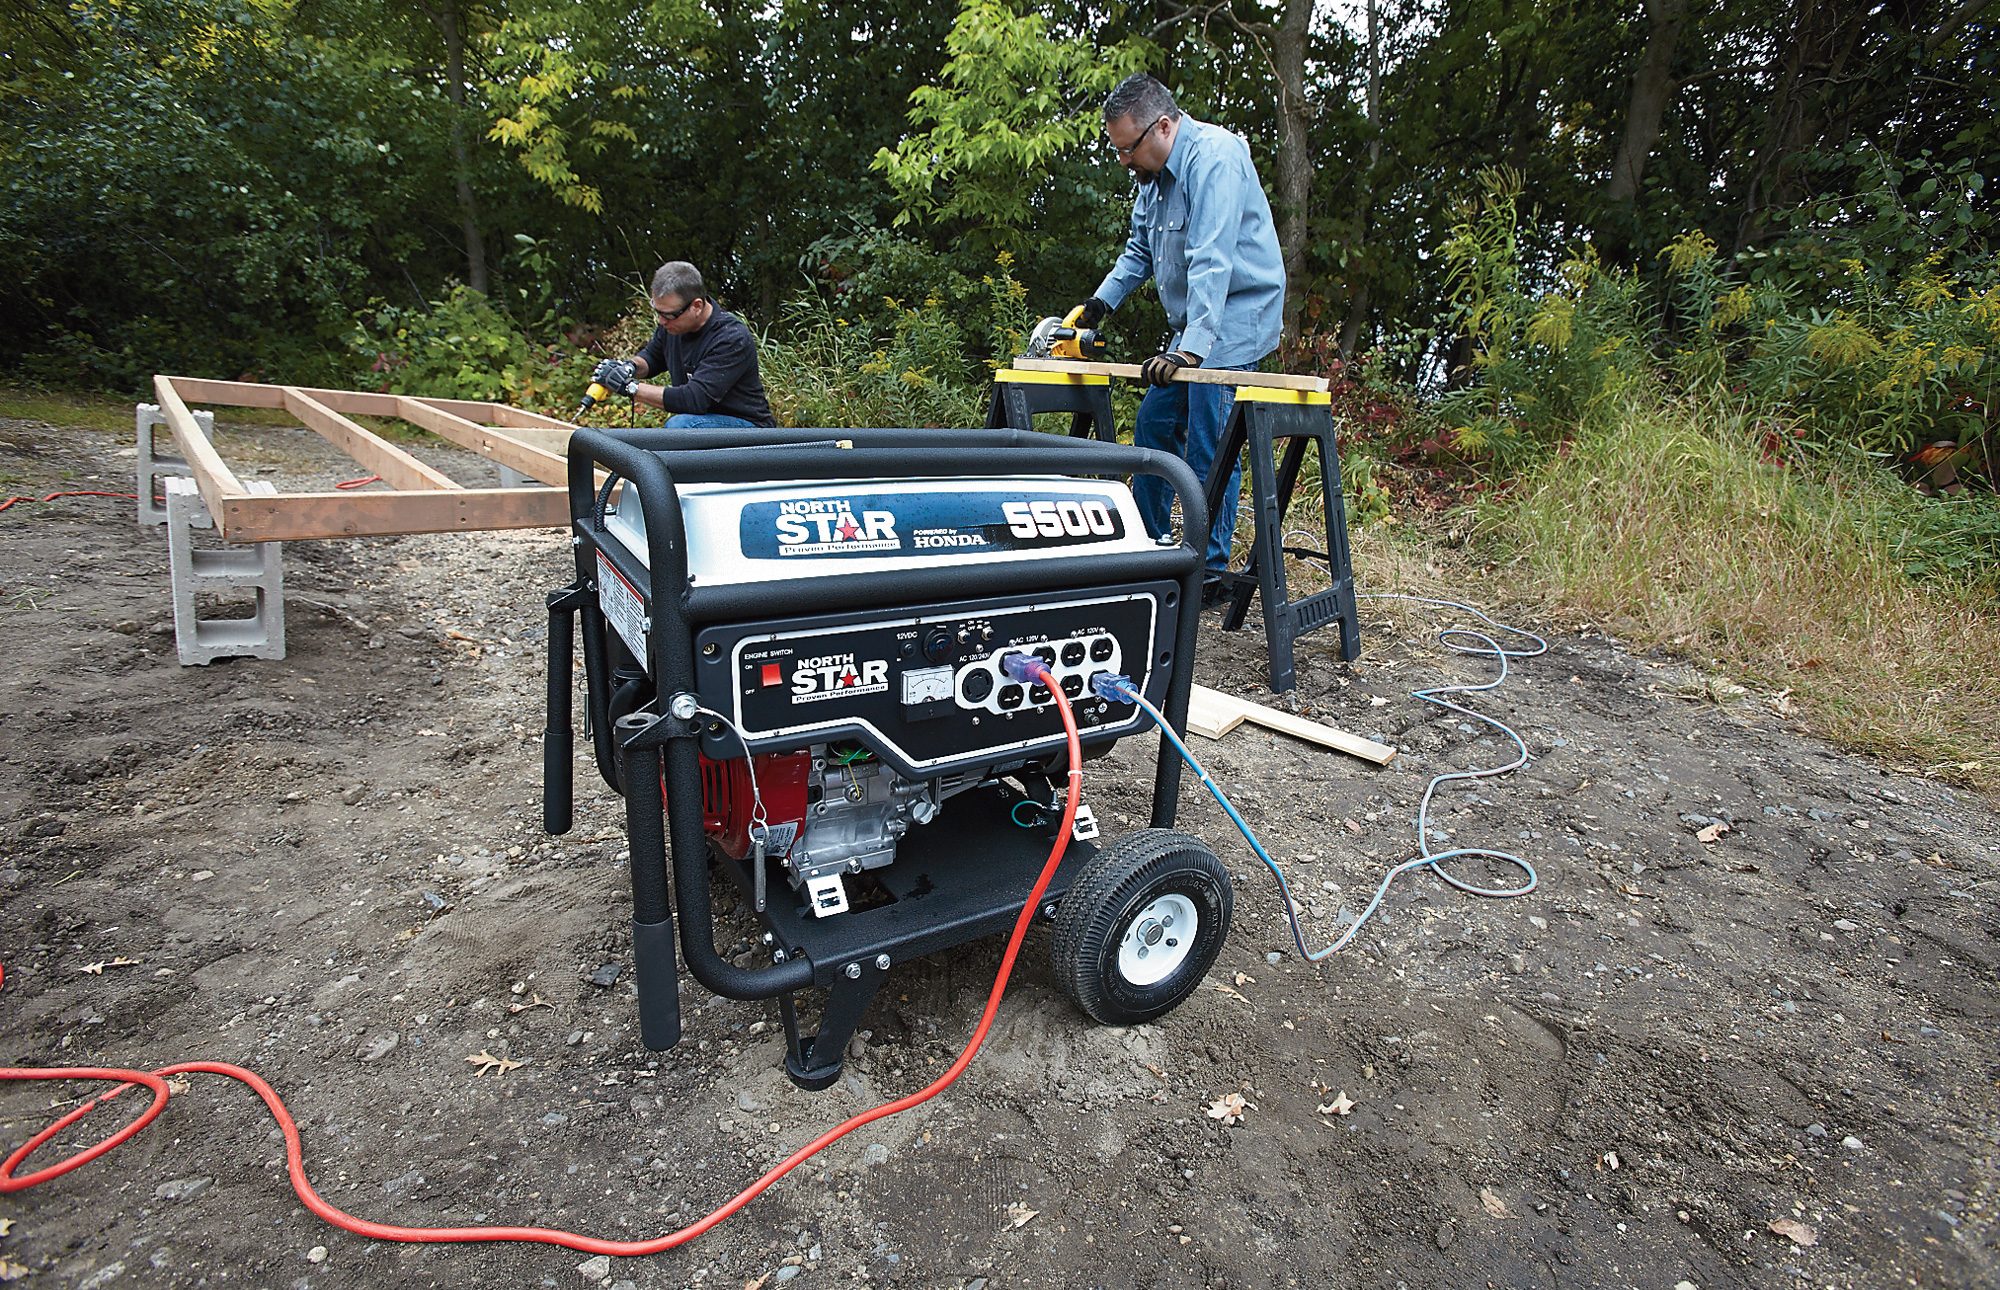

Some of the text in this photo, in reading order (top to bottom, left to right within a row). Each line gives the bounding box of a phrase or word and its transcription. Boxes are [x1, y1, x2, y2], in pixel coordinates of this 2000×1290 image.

[780, 500, 850, 515] NORTH
[776, 511, 899, 544] STAR
[1001, 501, 1115, 538] 5500
[785, 542, 896, 553] Proven Performance
[913, 535, 987, 548] HONDA
[896, 631, 918, 640] 12VDC
[744, 648, 793, 660] ENGINE SWITCH
[797, 653, 854, 670] NORTH
[791, 660, 889, 695] STAR
[796, 685, 885, 702] Proven Performance
